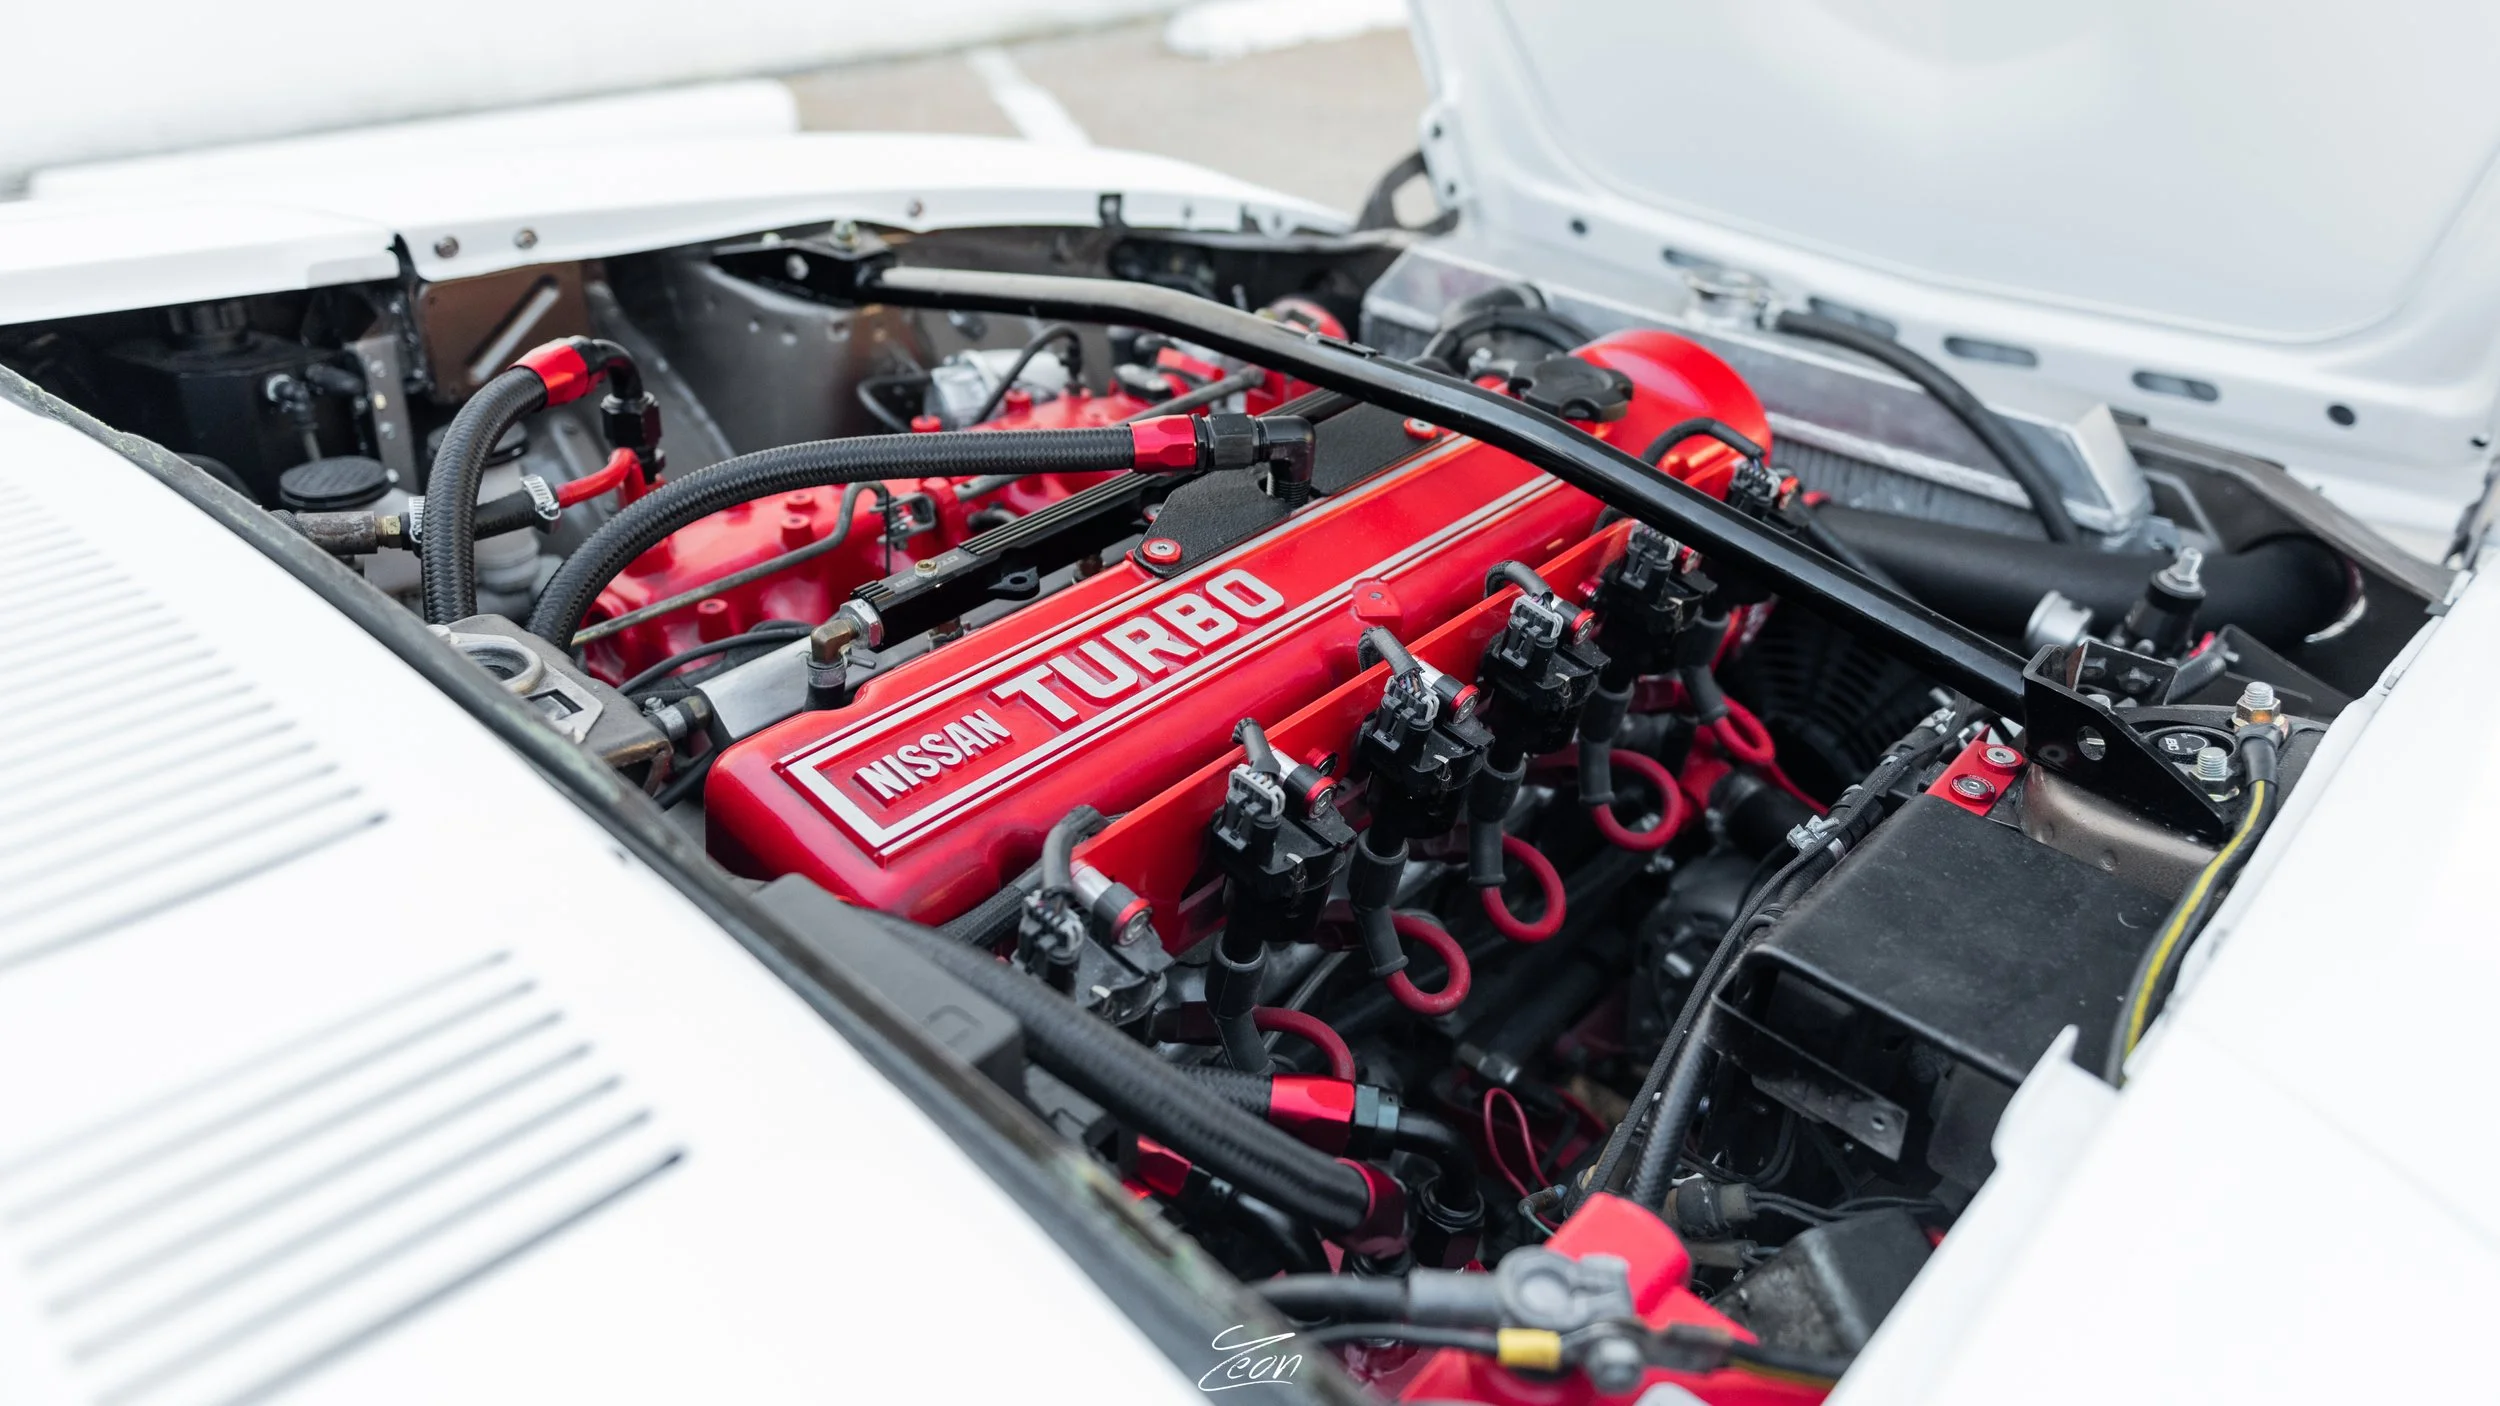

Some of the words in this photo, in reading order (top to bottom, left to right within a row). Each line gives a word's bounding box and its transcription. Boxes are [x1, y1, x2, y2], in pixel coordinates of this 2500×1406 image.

[855, 708, 1011, 800] NISSAN
[991, 568, 1285, 723] TURBO
[2164, 737, 2180, 751] BC
